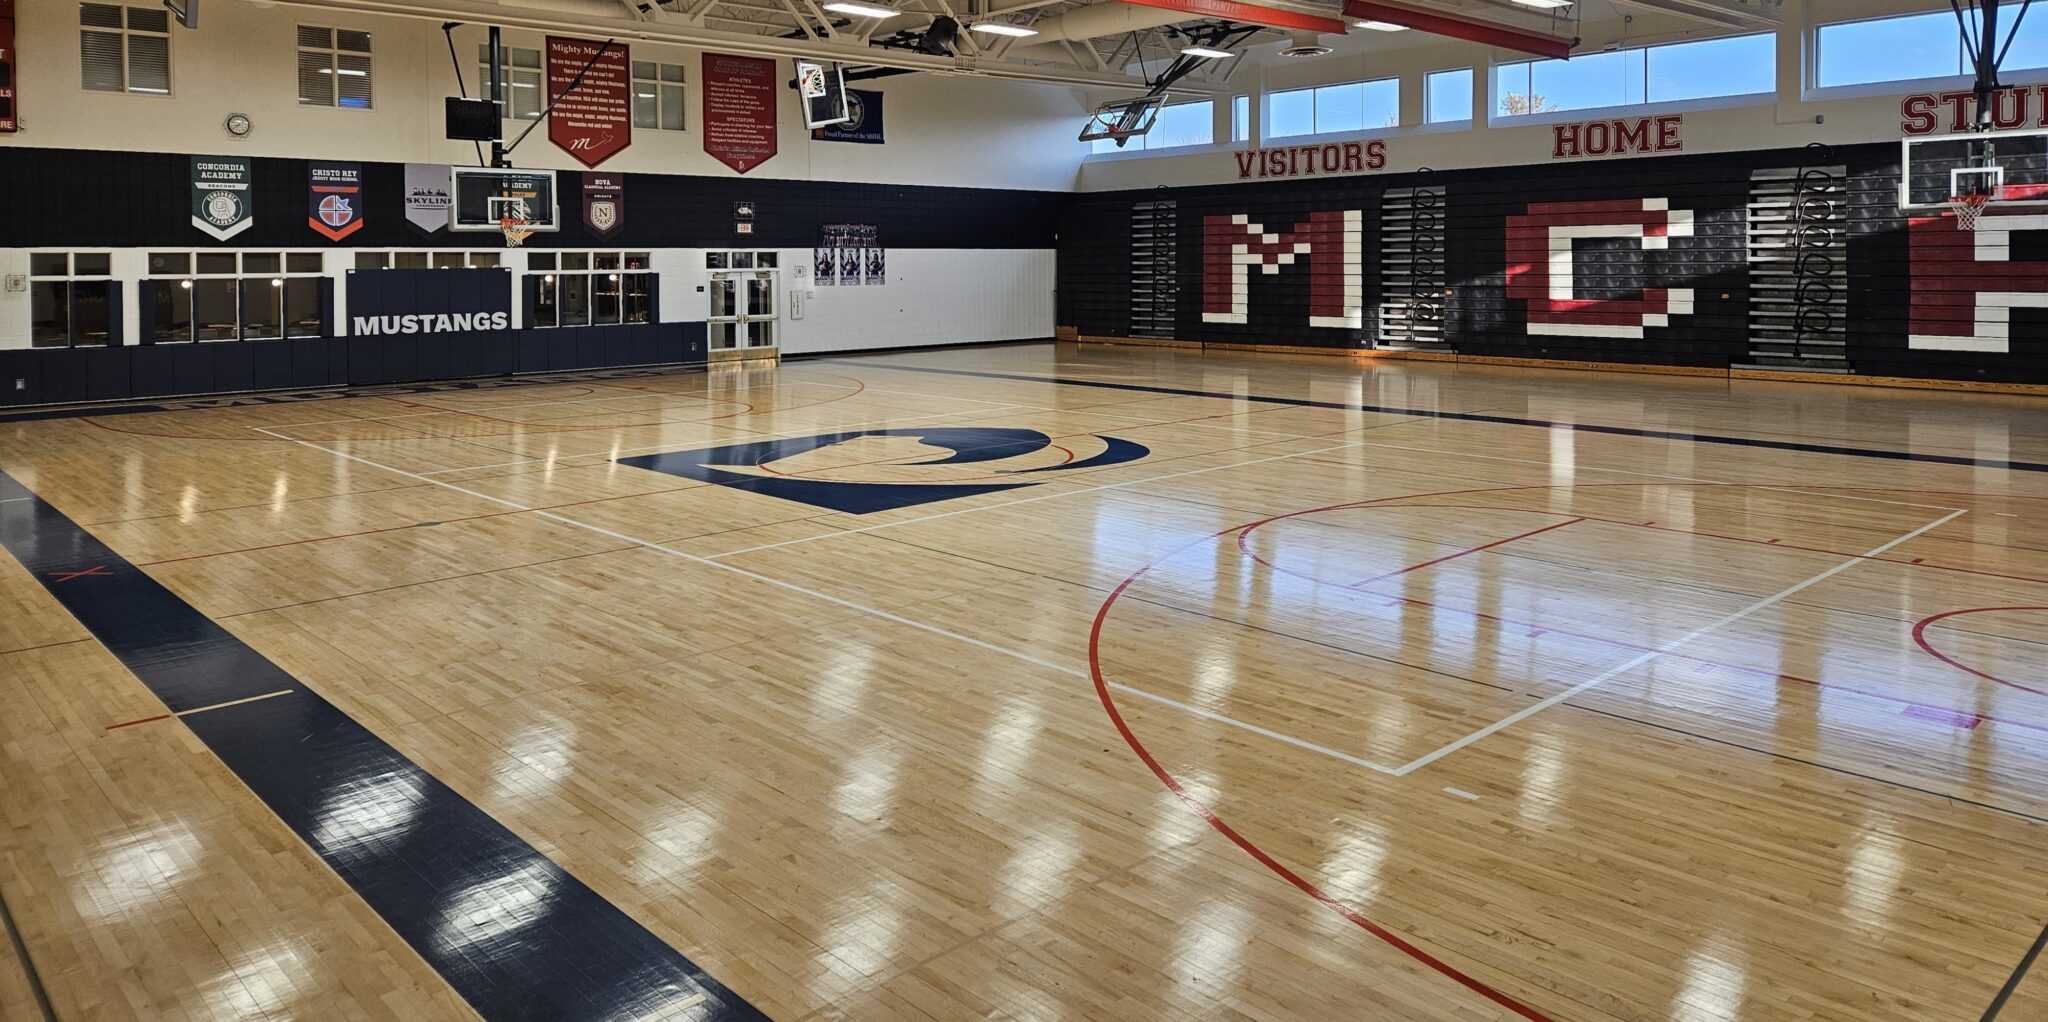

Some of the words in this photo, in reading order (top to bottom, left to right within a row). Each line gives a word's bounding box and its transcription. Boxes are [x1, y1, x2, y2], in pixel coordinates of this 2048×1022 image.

[552, 43, 581, 55] Mighty
[583, 46, 624, 59] Musangs!
[1900, 85, 2048, 136] STU
[1552, 114, 1683, 159] HOME
[197, 163, 245, 171] CONCORDIA
[1233, 139, 1386, 179] VISITORS
[201, 171, 242, 179] ACADEMY
[599, 207, 608, 217] N
[353, 311, 508, 336] MUSTANGS
